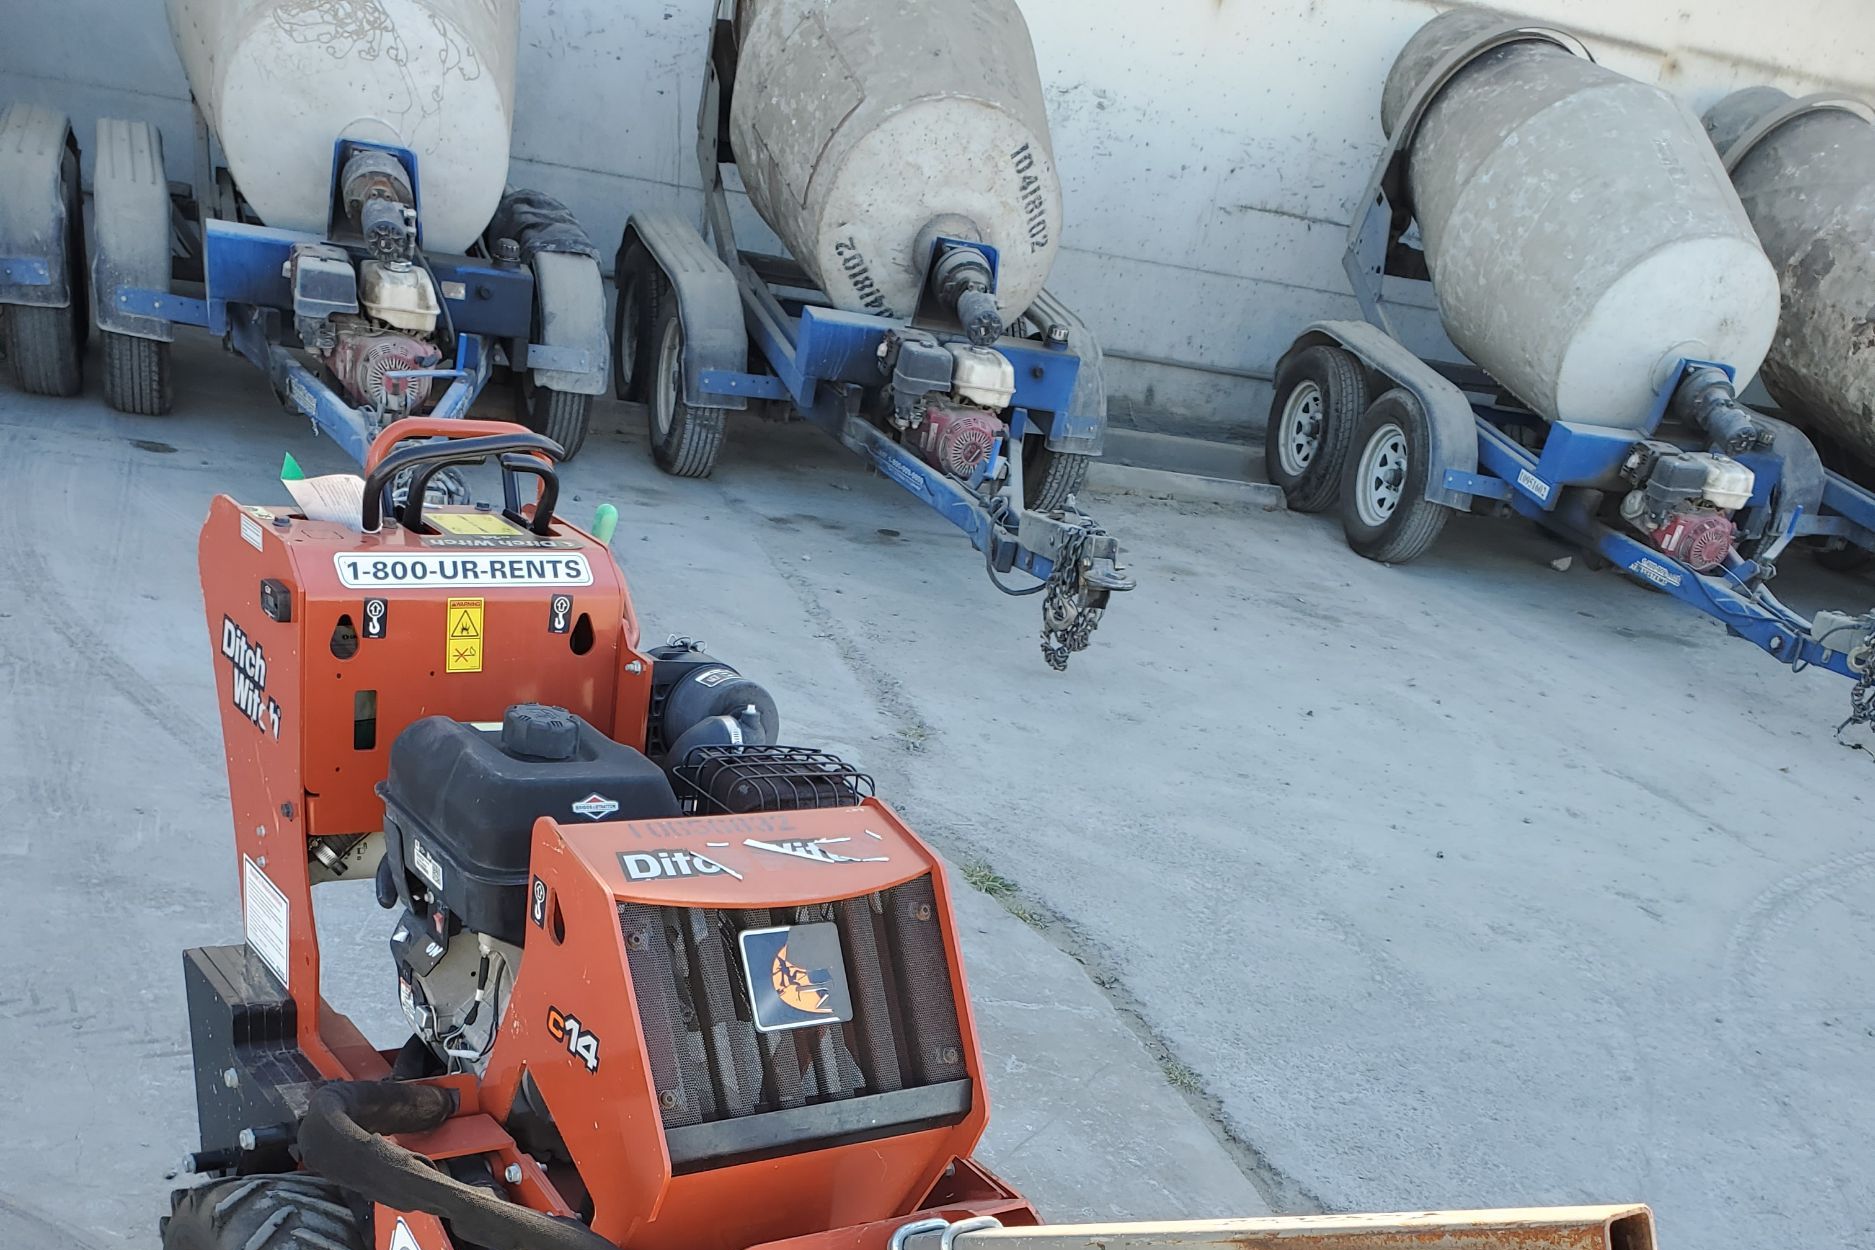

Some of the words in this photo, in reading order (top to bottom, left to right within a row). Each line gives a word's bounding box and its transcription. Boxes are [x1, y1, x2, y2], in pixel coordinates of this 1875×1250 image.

[1010, 142, 1049, 254] 10418102
[347, 559, 582, 581] 1-800-UR-RENTS
[222, 616, 267, 689] Ditch
[425, 942, 444, 958] ON
